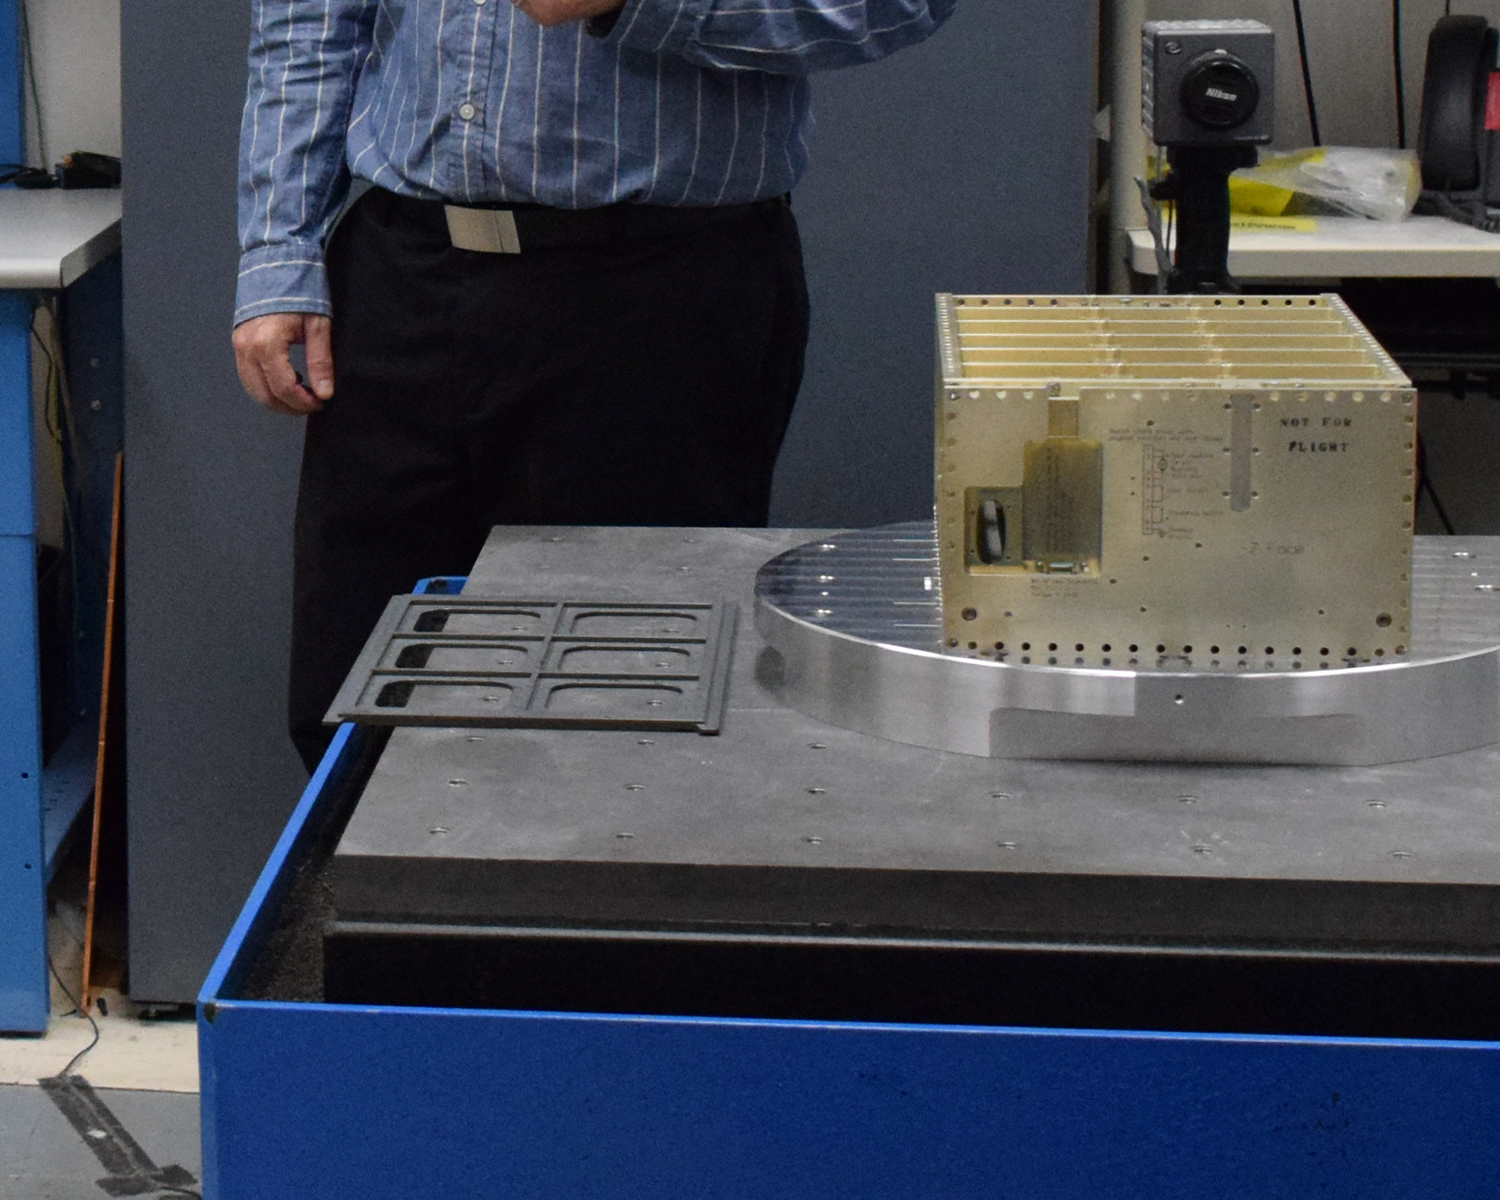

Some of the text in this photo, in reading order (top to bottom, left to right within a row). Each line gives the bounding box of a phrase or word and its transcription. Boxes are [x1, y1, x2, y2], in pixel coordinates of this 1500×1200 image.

[1279, 417, 1352, 428] NOT FOR
[1288, 441, 1349, 453] FLIGHT
